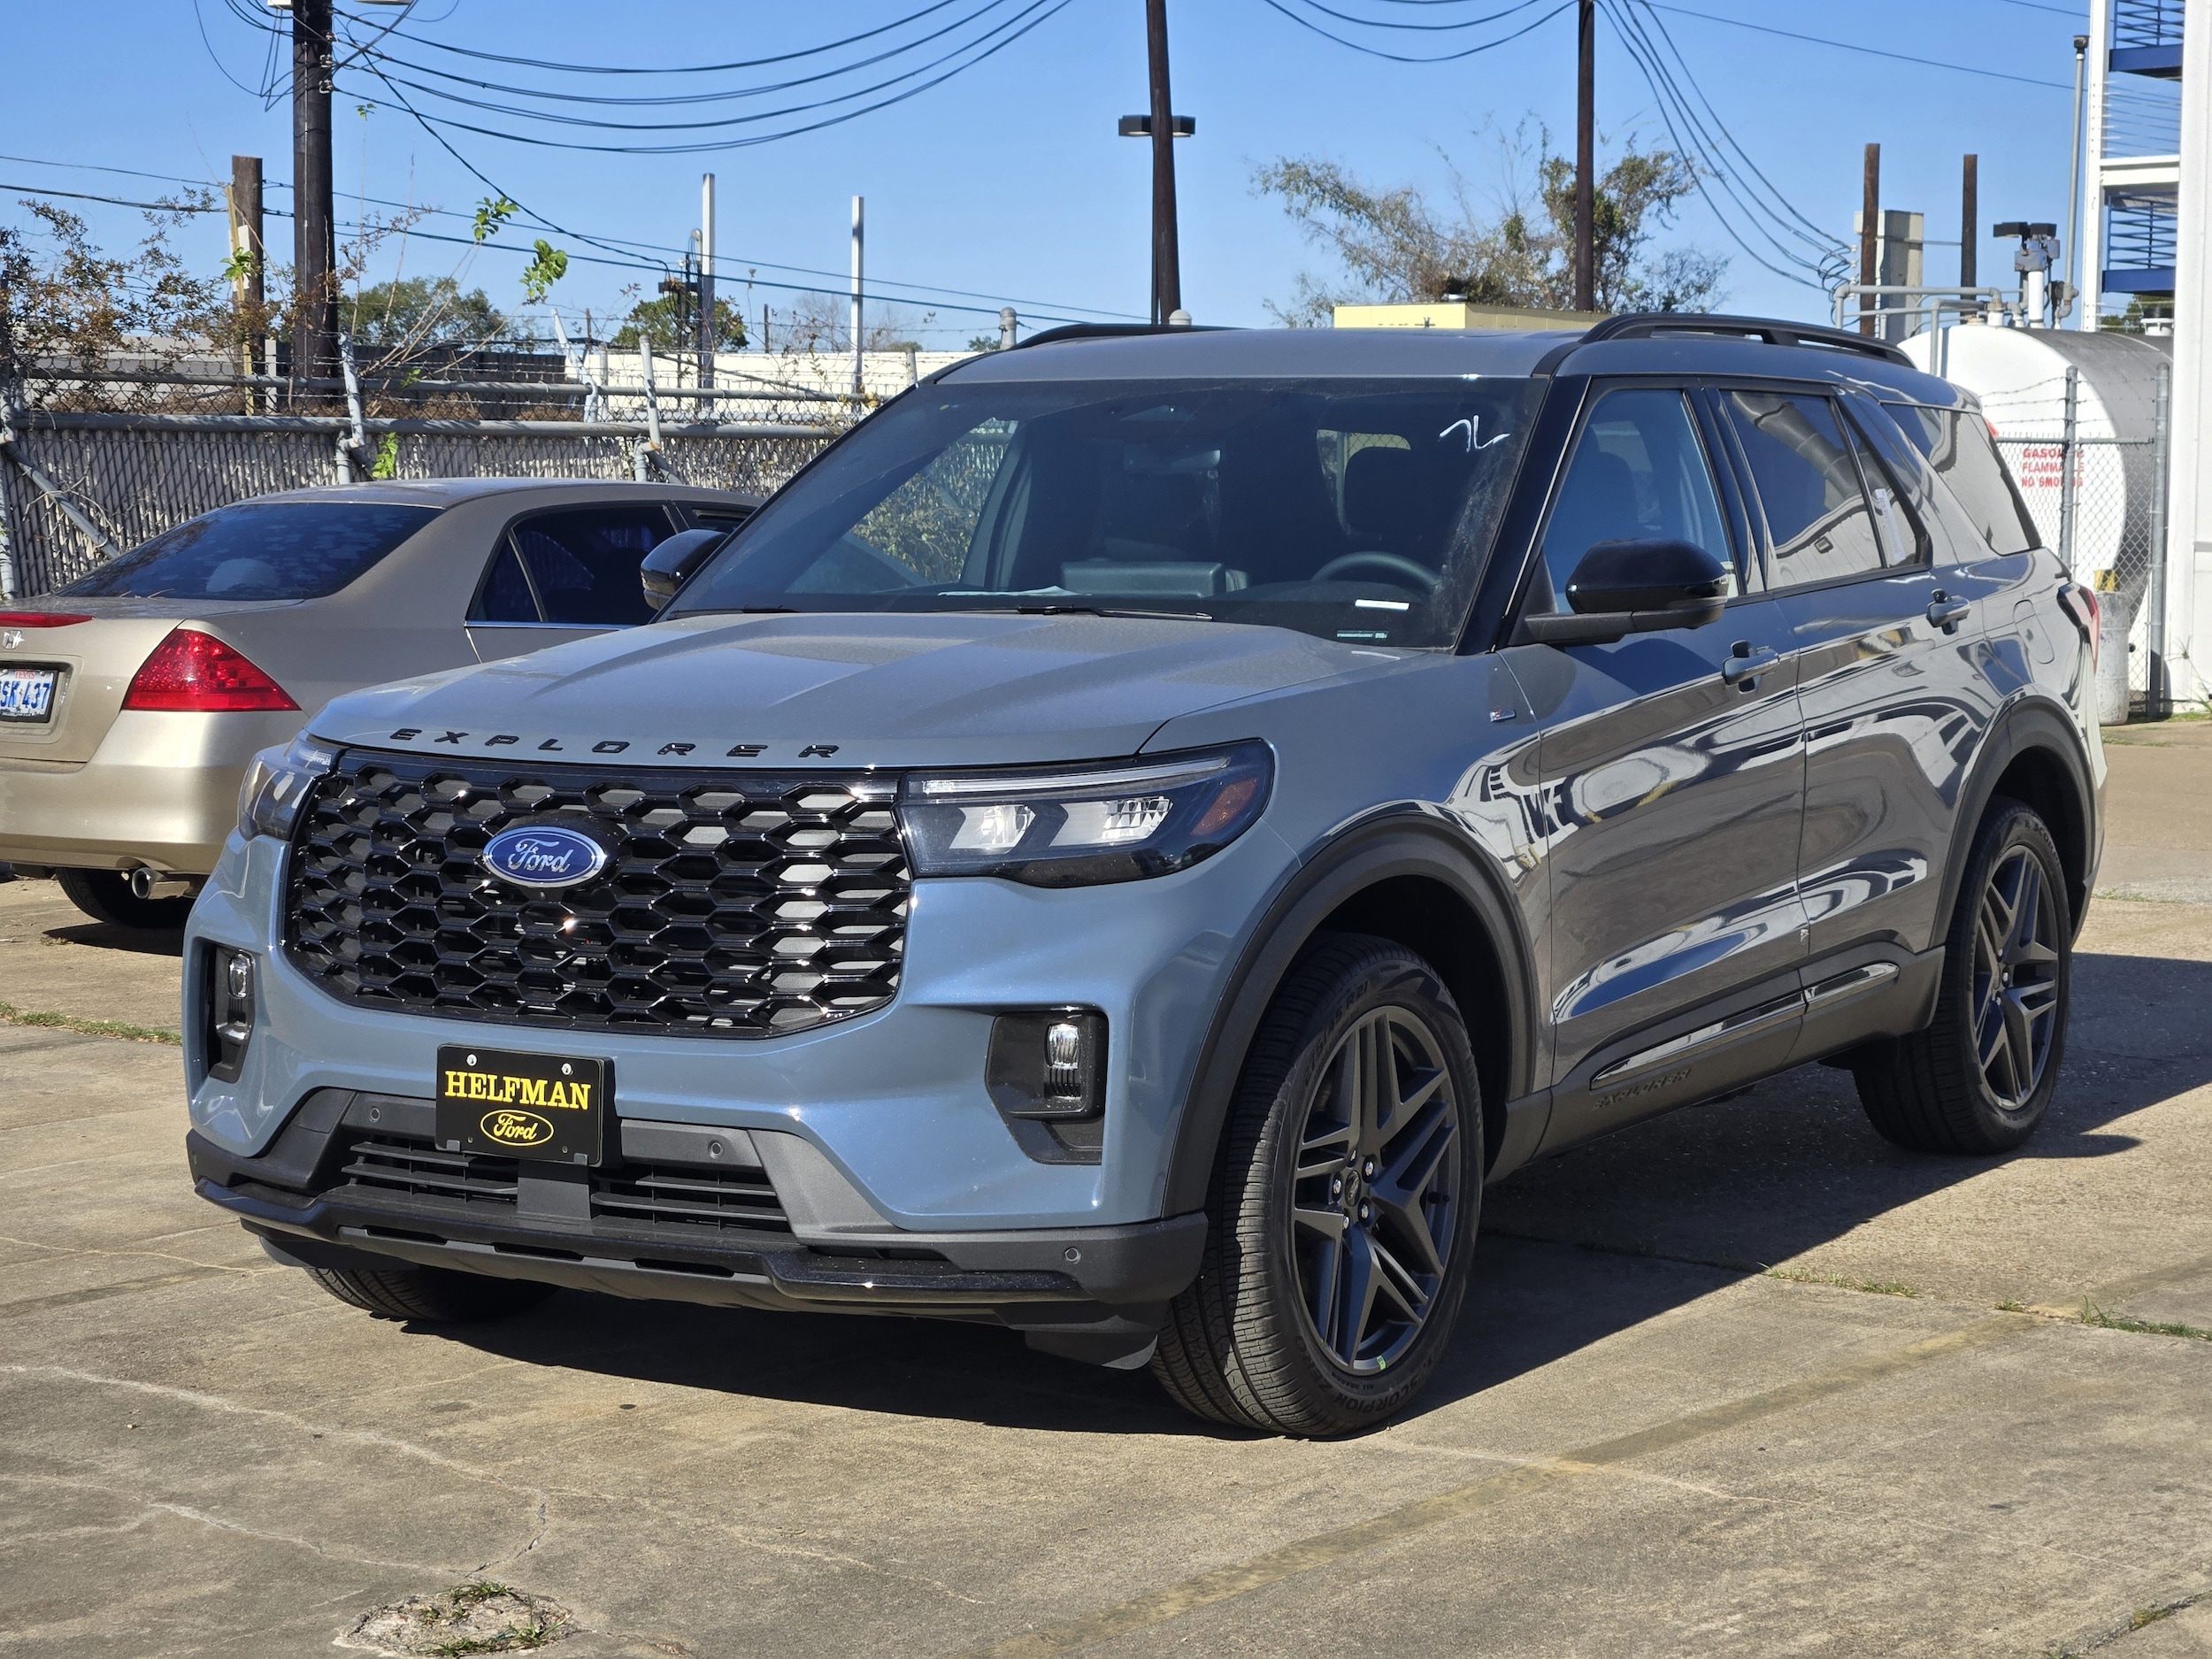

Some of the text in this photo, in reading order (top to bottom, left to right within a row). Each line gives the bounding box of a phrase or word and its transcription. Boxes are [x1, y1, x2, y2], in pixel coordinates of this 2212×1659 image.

[2021, 477, 2035, 488] NO
[0, 680, 50, 709] SK 437
[389, 728, 840, 758] EXPLORER
[508, 838, 573, 873] Ford
[445, 1071, 592, 1110] HELFMAN
[493, 1113, 539, 1141] Ford
[1333, 1373, 1419, 1413] SCORPION
